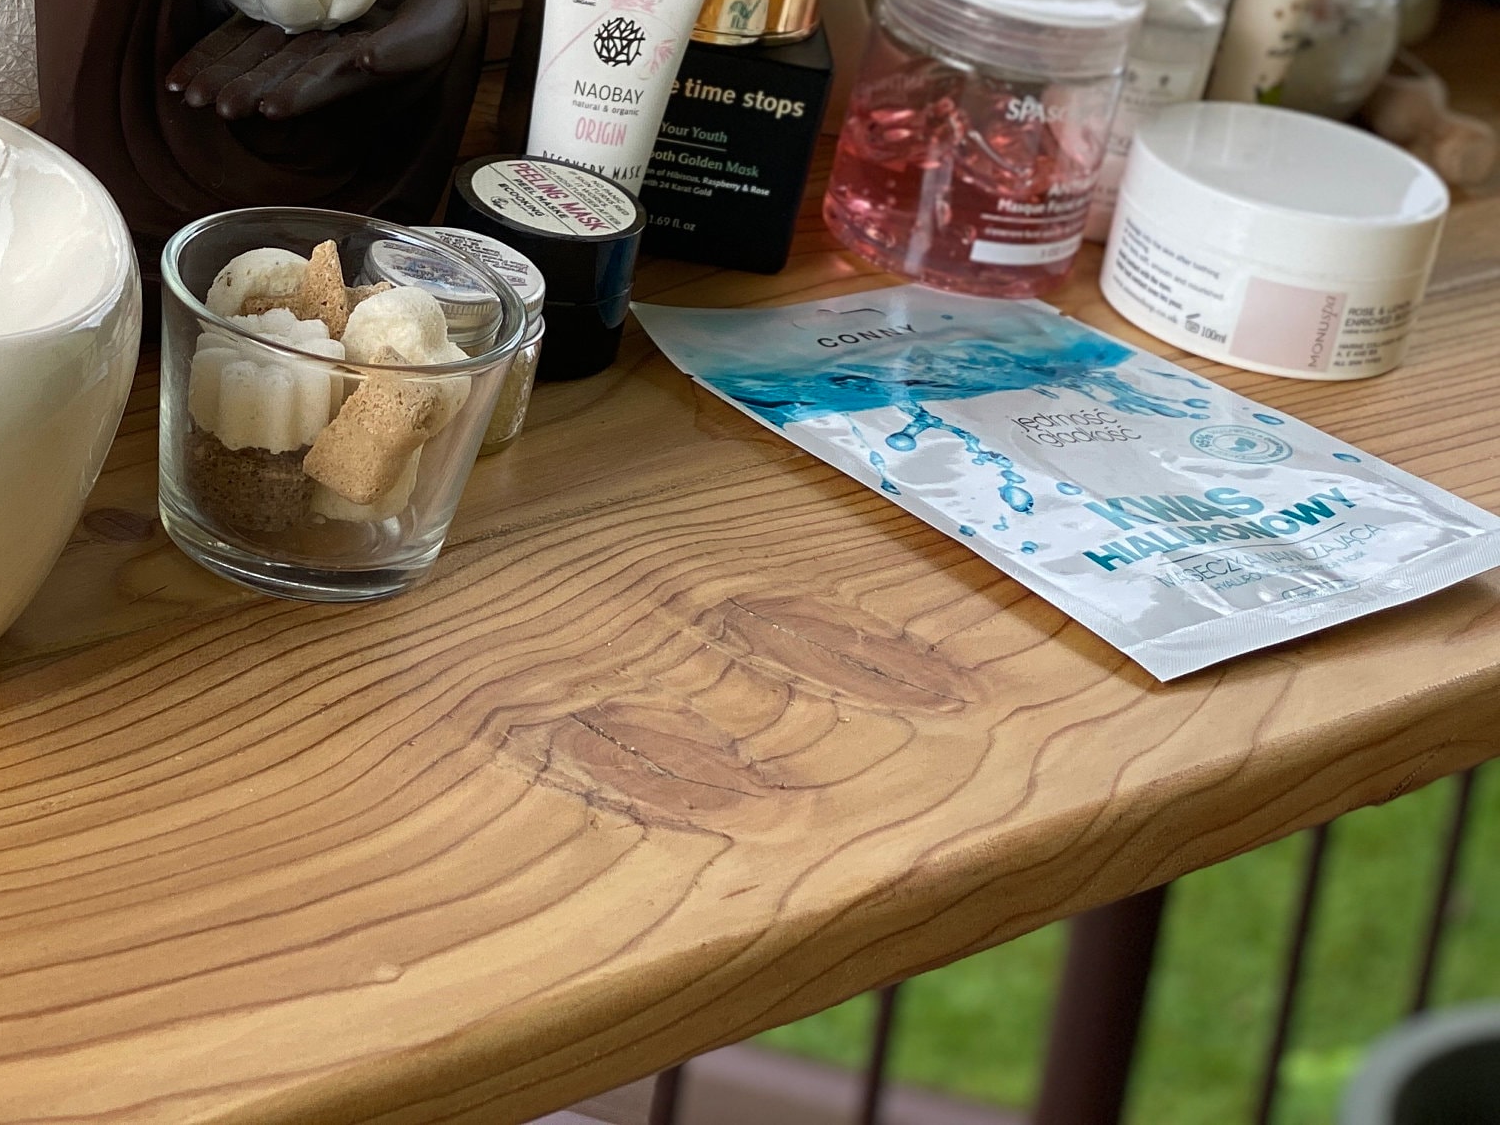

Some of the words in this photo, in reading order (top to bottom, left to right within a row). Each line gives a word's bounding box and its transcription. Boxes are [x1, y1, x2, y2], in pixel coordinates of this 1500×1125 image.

[573, 79, 645, 105] NAOBAY
[684, 78, 736, 104] time
[743, 90, 805, 119] stops
[572, 99, 600, 111] natural
[611, 107, 640, 116] organic
[575, 116, 628, 147] ORIGIN
[691, 126, 728, 144] Youth
[612, 164, 642, 181] MASK
[678, 152, 723, 171] Golden
[725, 160, 759, 178] Mask
[506, 162, 570, 200] PEELING
[558, 202, 612, 231] MASK
[513, 178, 537, 195] PEEL
[535, 195, 571, 219] MASKE
[660, 180, 670, 189] 24
[671, 182, 692, 194] Karat
[693, 186, 713, 197] Gold
[702, 176, 741, 192] Raspberry
[750, 185, 771, 196] Rose
[498, 183, 546, 218] ECOOKING
[683, 221, 697, 232] oz
[1348, 307, 1376, 316] ROSE
[817, 324, 916, 348] CONNY
[1201, 326, 1228, 344] 100ml
[1307, 295, 1338, 368] MONUspa
[1082, 487, 1265, 531] KWAS
[1081, 487, 1358, 572] HIALURONOWY
